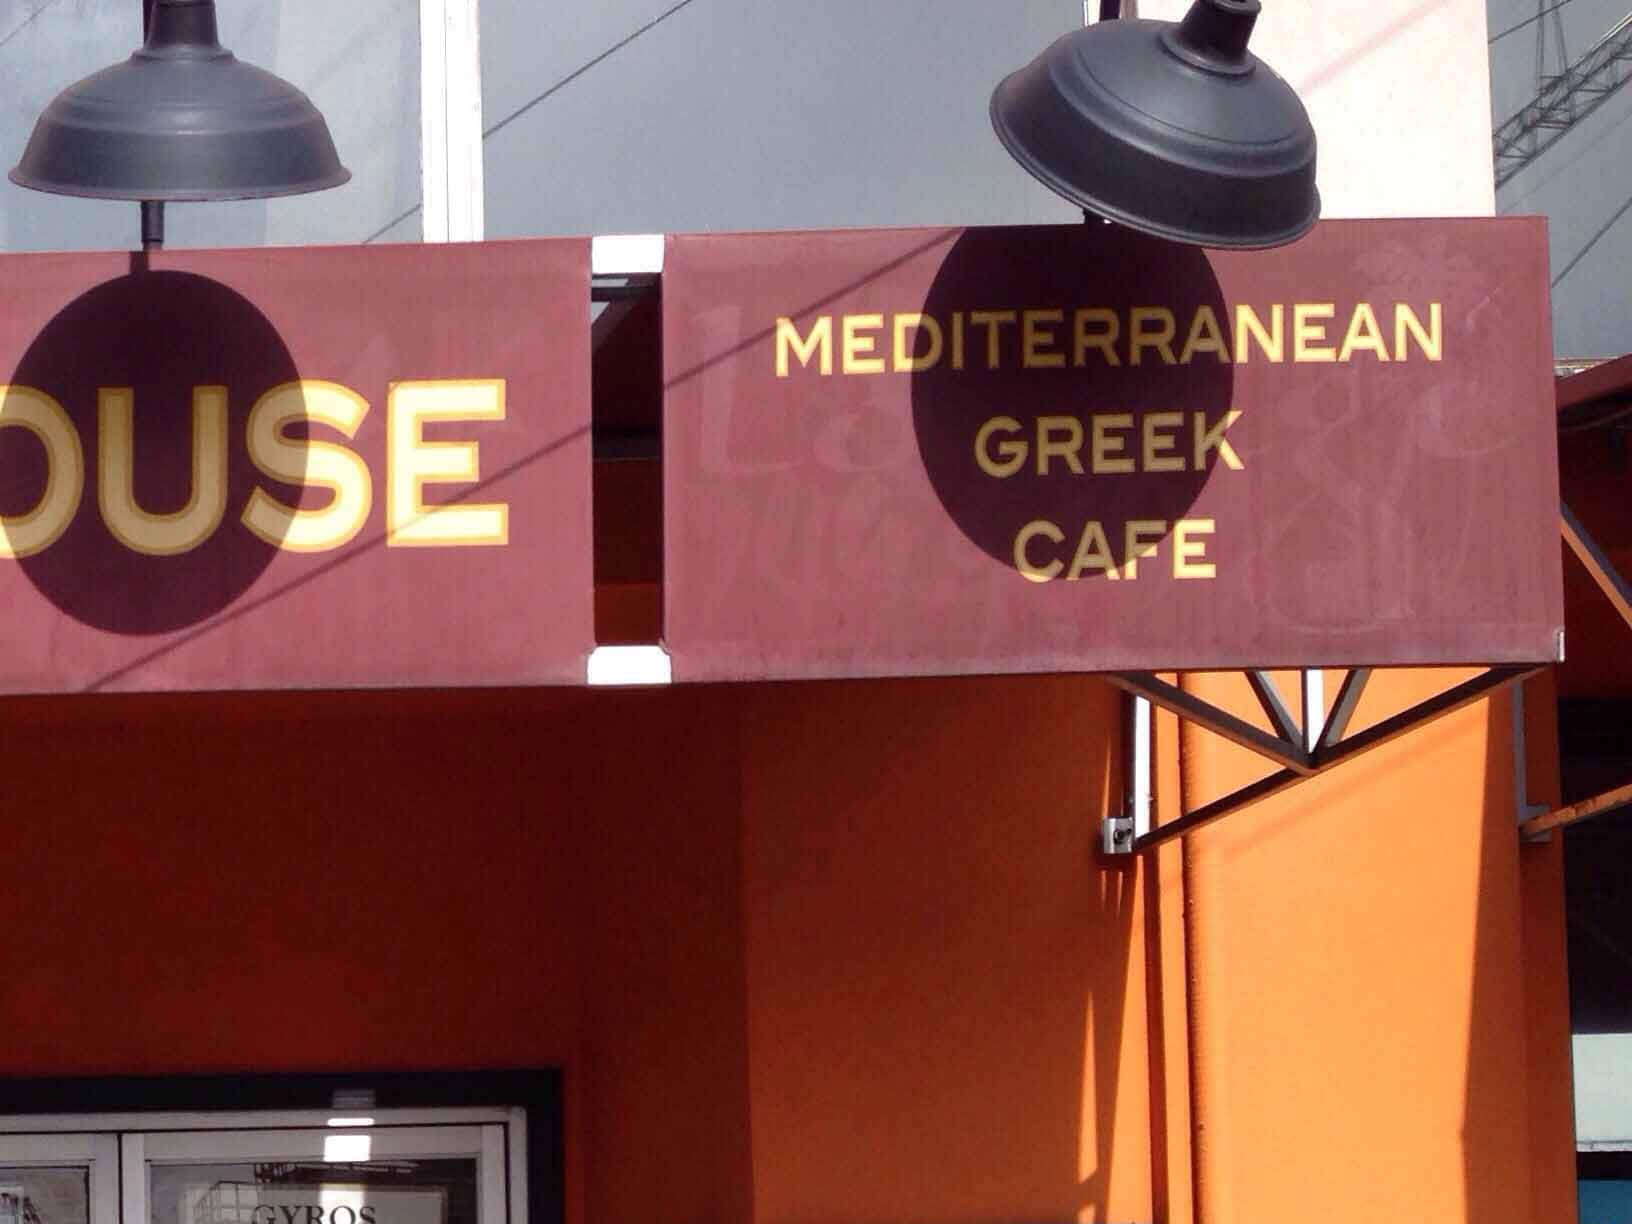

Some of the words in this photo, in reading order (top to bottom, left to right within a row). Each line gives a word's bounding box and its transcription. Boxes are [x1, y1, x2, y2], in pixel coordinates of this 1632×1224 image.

[773, 301, 1443, 378] MEDITERRANEAN
[974, 409, 1244, 477] GREEK
[1013, 518, 1218, 584] CAFE
